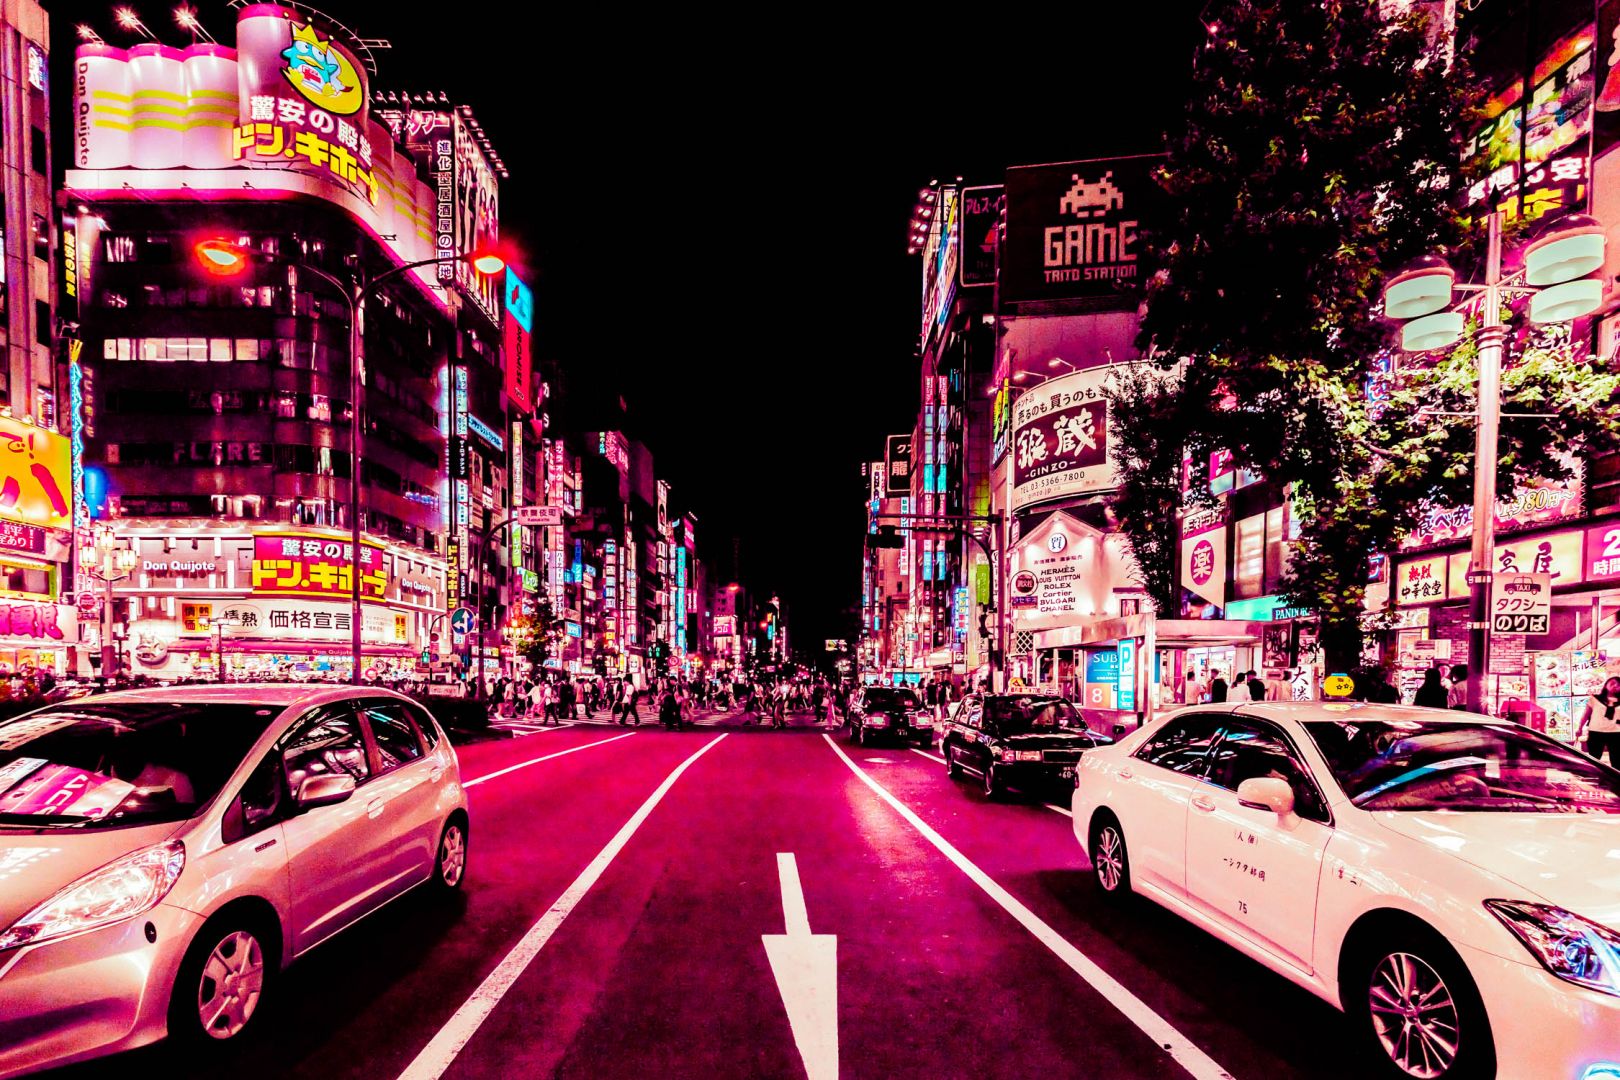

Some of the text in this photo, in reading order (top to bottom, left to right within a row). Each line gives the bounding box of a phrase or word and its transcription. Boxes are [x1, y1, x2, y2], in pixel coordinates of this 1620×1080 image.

[78, 62, 90, 165] Don Quijote
[250, 95, 373, 167] 驚安の殿堂
[1044, 220, 1138, 268] GAME
[1044, 265, 1137, 283] TAITO STATION
[282, 539, 373, 564] 驚安の殿堂
[143, 561, 215, 572] Don Quijote
[1193, 545, 1212, 580] 薬
[1043, 590, 1072, 598] Cartier
[1044, 582, 1071, 590] ROLEX
[1402, 580, 1442, 600] 中華食堂
[1515, 584, 1531, 592] TAXI
[1040, 597, 1076, 605] BVLGARI
[1496, 598, 1548, 612] タクシー
[269, 610, 351, 630] 価格宣言
[1496, 616, 1547, 632] のりば
[1092, 688, 1103, 703] 8
[1238, 900, 1248, 915] 75
